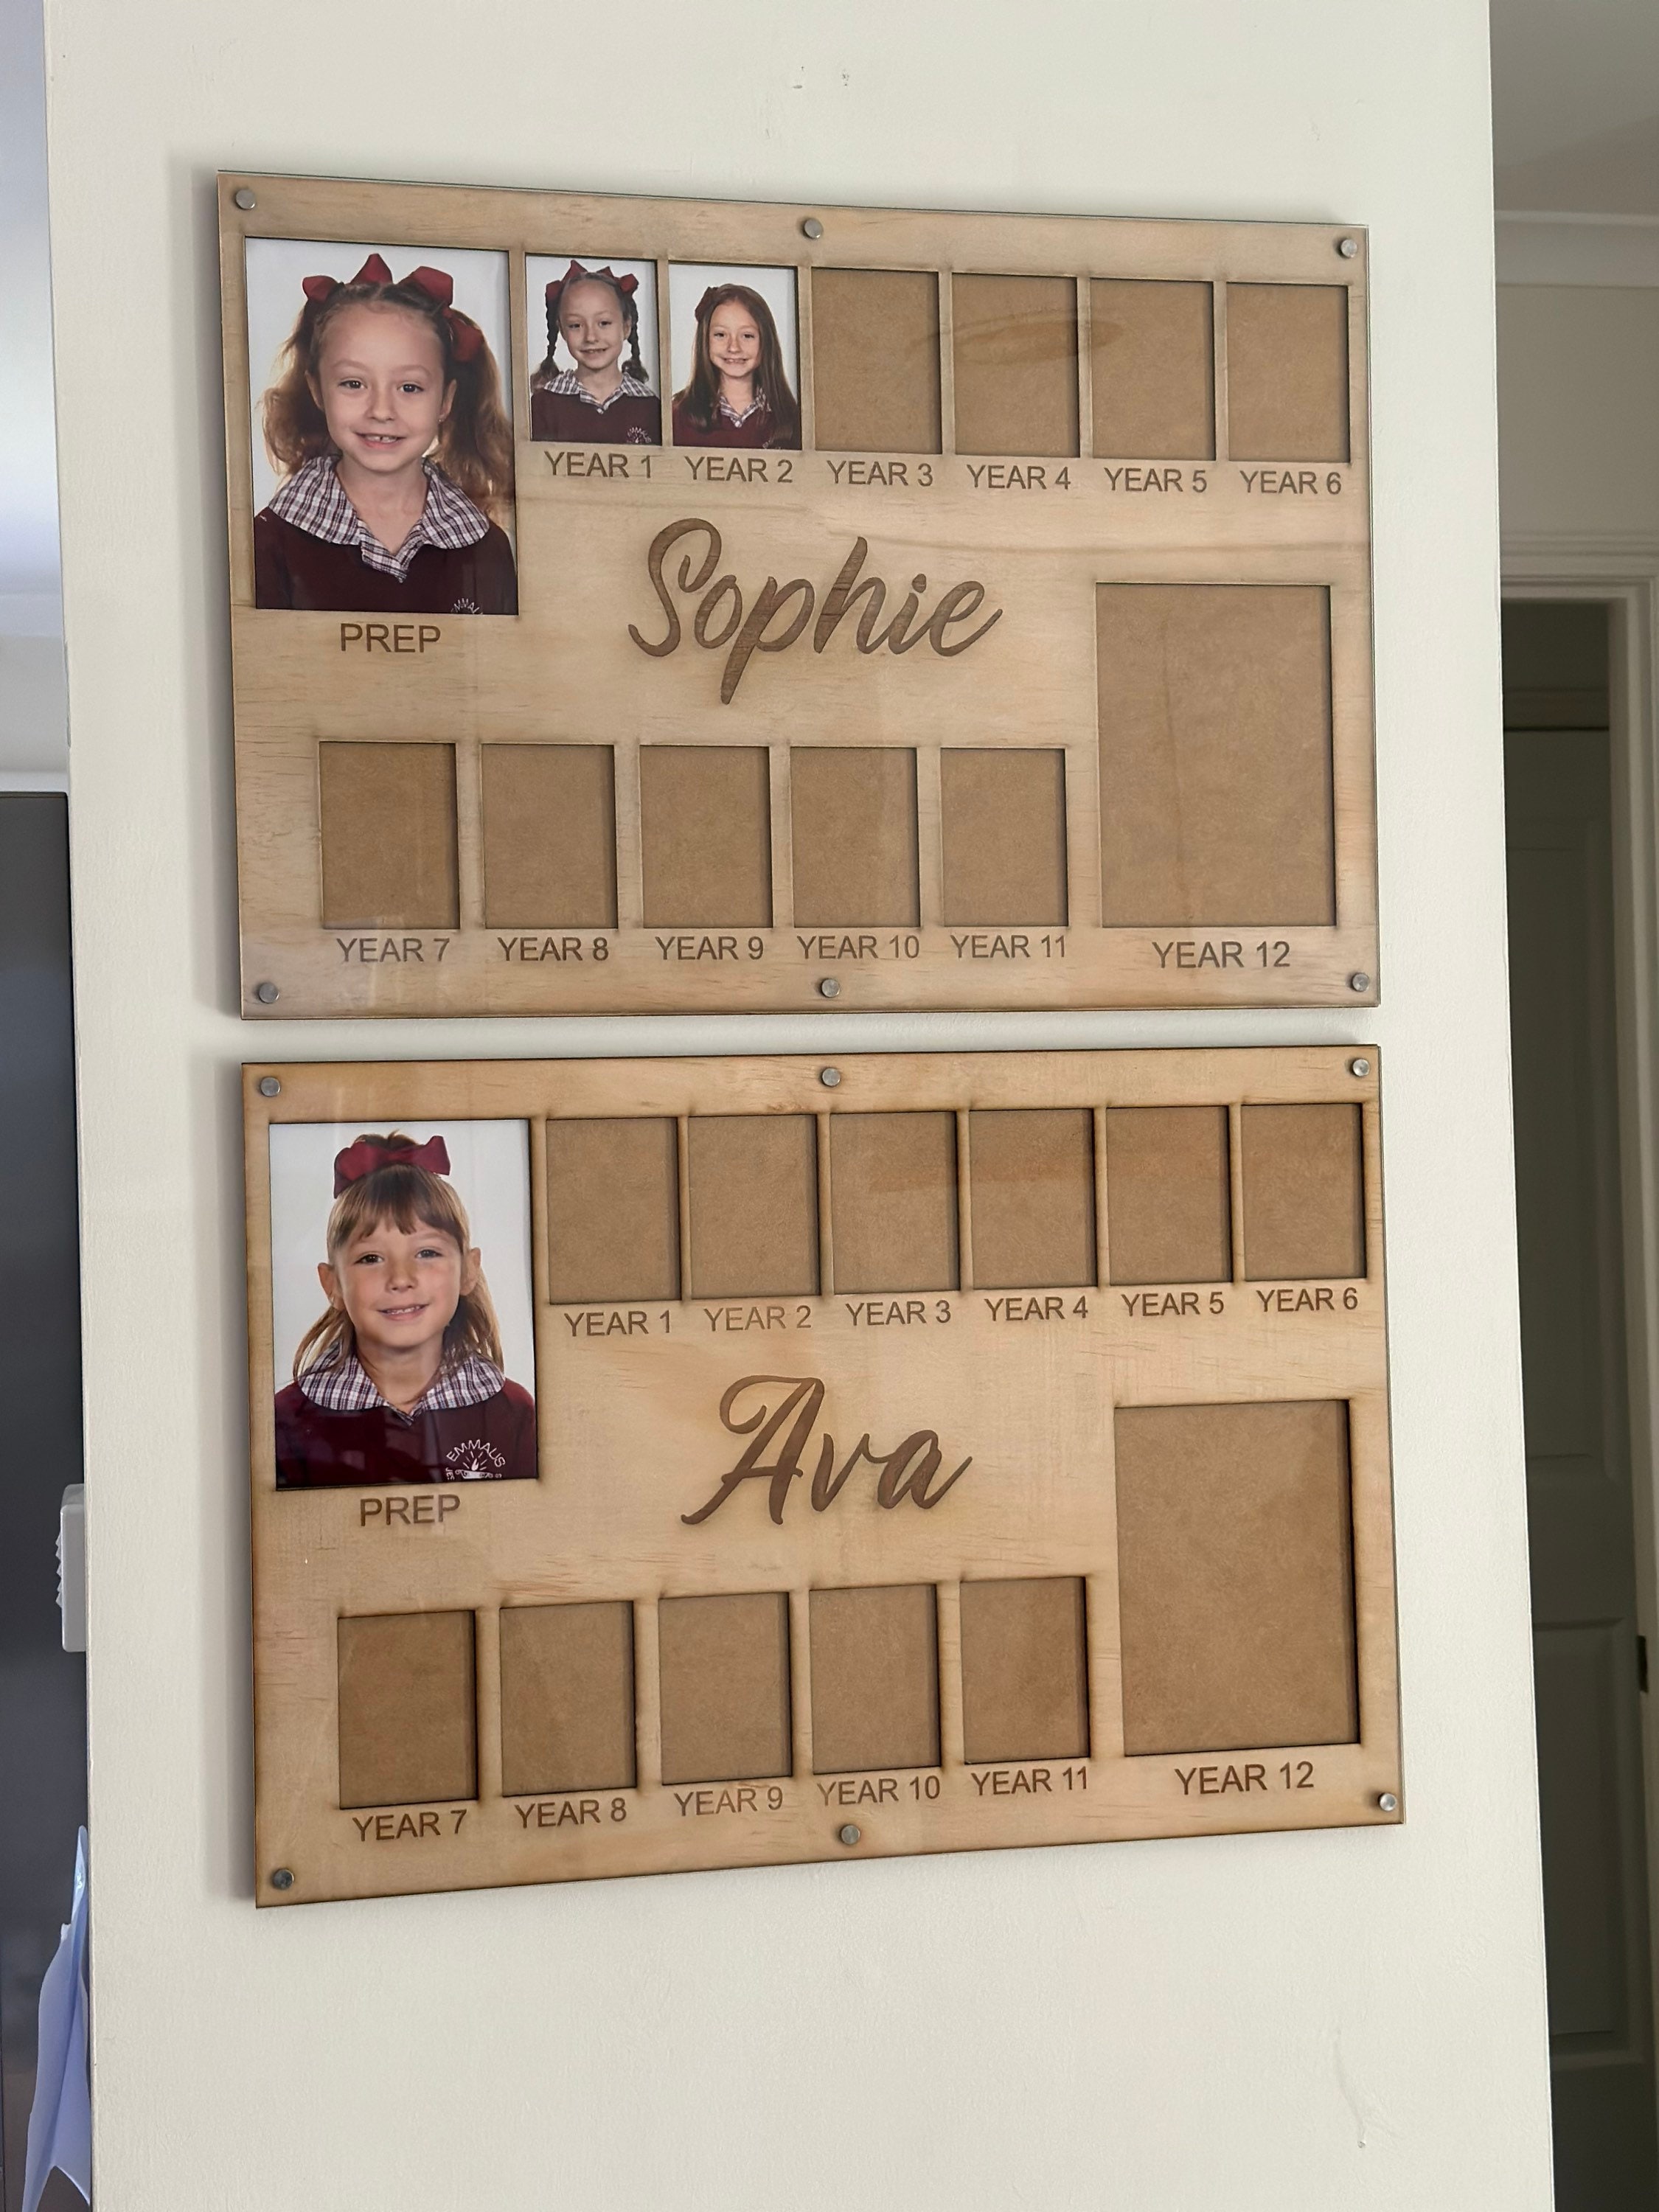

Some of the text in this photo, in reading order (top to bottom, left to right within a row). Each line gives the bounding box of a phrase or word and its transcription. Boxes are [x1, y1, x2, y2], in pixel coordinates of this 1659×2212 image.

[543, 451, 651, 479] YEAR 1
[684, 456, 793, 484] YEAR 2
[827, 460, 933, 487] YEAR 3
[966, 464, 1071, 490] YEAR 4
[1104, 467, 1207, 493] YEAR 5
[1239, 470, 1342, 495] YEAR 6
[627, 518, 1004, 706] Sophie
[340, 623, 441, 653] PREP
[335, 937, 451, 963] YEAR 7
[497, 936, 609, 961] YEAR 8
[655, 936, 764, 961] YEAR 9
[796, 935, 919, 960] YEAR 10
[950, 934, 1065, 959] YEAR 11
[1152, 941, 1290, 969] YEAR 12
[845, 1299, 951, 1326] YEAR 3
[984, 1295, 1088, 1322] YEAR 4
[1121, 1291, 1224, 1317] YEAR 5
[1256, 1287, 1358, 1312] YEAR 6
[563, 1310, 670, 1338] YEAR 1
[703, 1304, 812, 1332] YEAR 2
[446, 1439, 506, 1467] EMMAUS
[680, 1374, 973, 1526] Ava
[360, 1494, 461, 1527] PREP
[816, 1775, 940, 1806] YEAR 10
[970, 1766, 1087, 1796] YEAR 11
[1174, 1761, 1315, 1795] YEAR 12
[514, 1797, 627, 1829] YEAR 8
[673, 1786, 783, 1817] YEAR 9
[352, 1809, 467, 1842] YEAR 7
